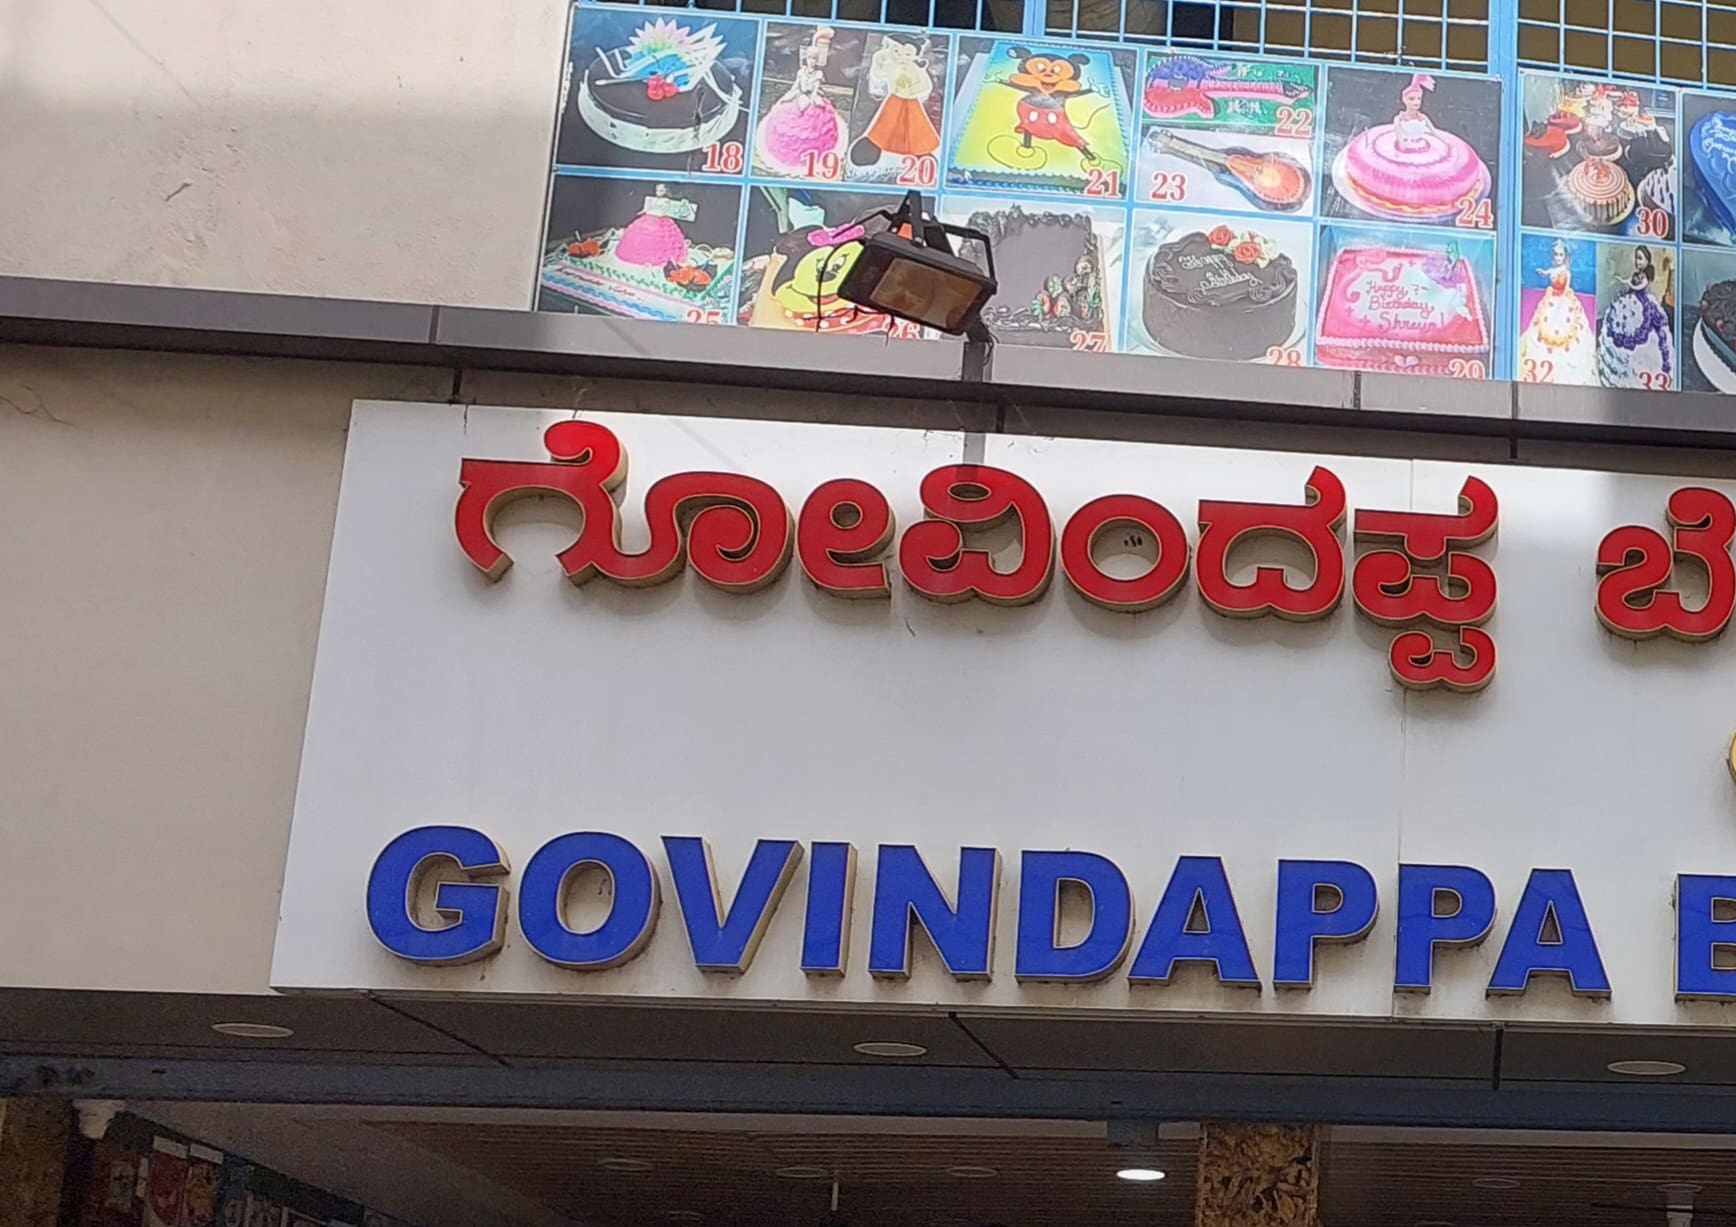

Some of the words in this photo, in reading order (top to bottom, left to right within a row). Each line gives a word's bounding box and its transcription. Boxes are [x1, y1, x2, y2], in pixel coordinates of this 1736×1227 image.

[1276, 109, 1310, 135] 22
[704, 143, 741, 171] 18
[803, 152, 839, 179] 19
[899, 157, 935, 185] 20
[1086, 170, 1120, 196] 21
[1153, 172, 1185, 200] 23
[1458, 199, 1492, 227] 24
[1638, 208, 1667, 237] 30
[1525, 359, 1553, 381] 32
[455, 420, 1498, 686] ಗೋವಿಂದಪ್ಪ
[368, 826, 1610, 994] GOVINDAPPA
